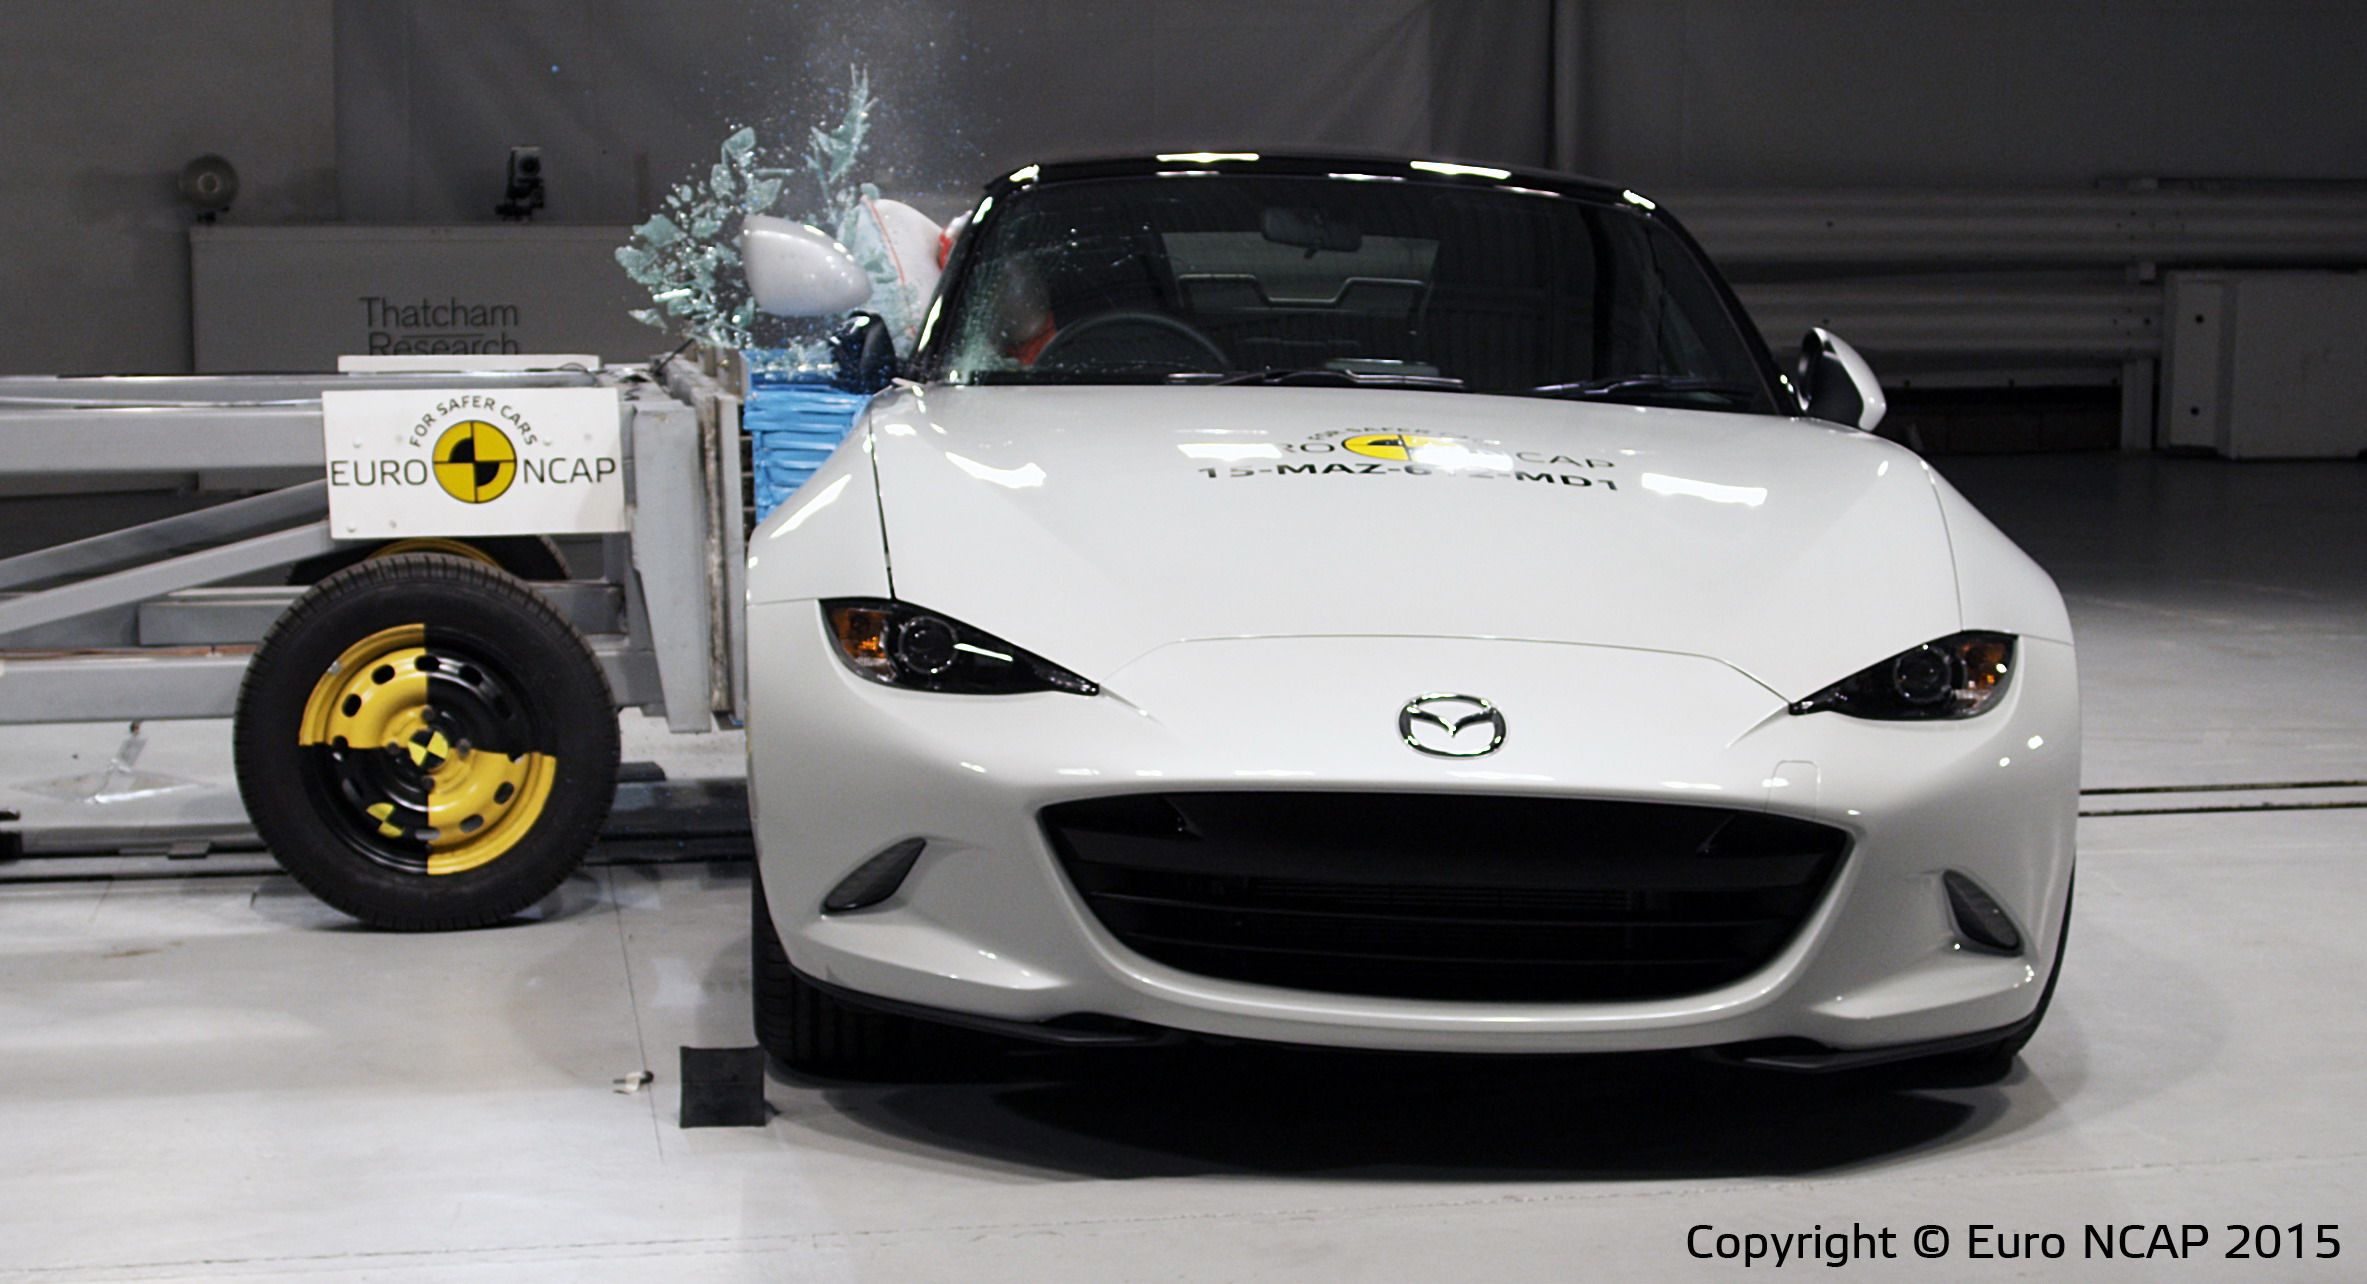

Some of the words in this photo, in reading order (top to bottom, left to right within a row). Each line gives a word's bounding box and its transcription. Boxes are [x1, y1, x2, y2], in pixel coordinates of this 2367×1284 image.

[358, 296, 519, 328] Thatcham
[368, 331, 519, 355] Research
[408, 412, 437, 448] FOR
[436, 395, 496, 417] SAFER
[499, 404, 538, 446] CARS
[330, 459, 428, 487] EURO
[523, 457, 616, 484] NCAP
[1515, 452, 1616, 468] CAP
[1197, 462, 1618, 491] 15-MAZ-6-MD1
